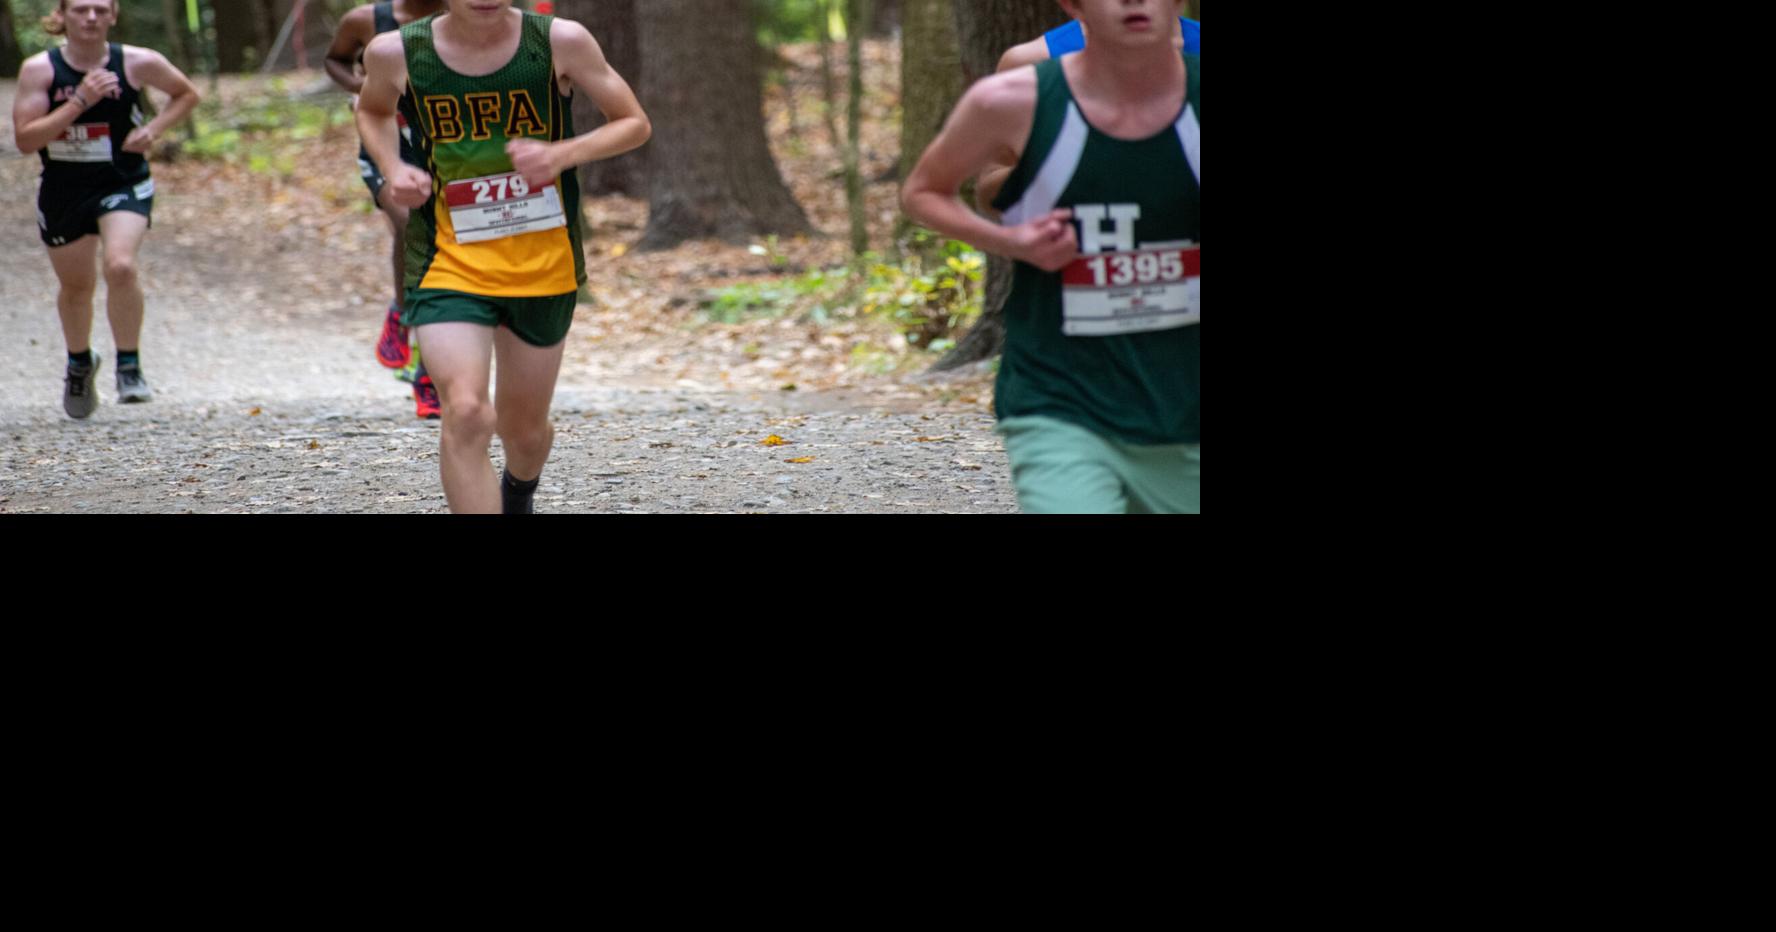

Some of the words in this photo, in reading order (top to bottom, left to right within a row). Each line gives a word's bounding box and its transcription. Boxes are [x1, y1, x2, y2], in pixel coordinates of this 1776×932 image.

[423, 89, 547, 143] BFA
[472, 175, 529, 204] 279
[1074, 203, 1141, 254] H
[1087, 251, 1184, 287] 1395
